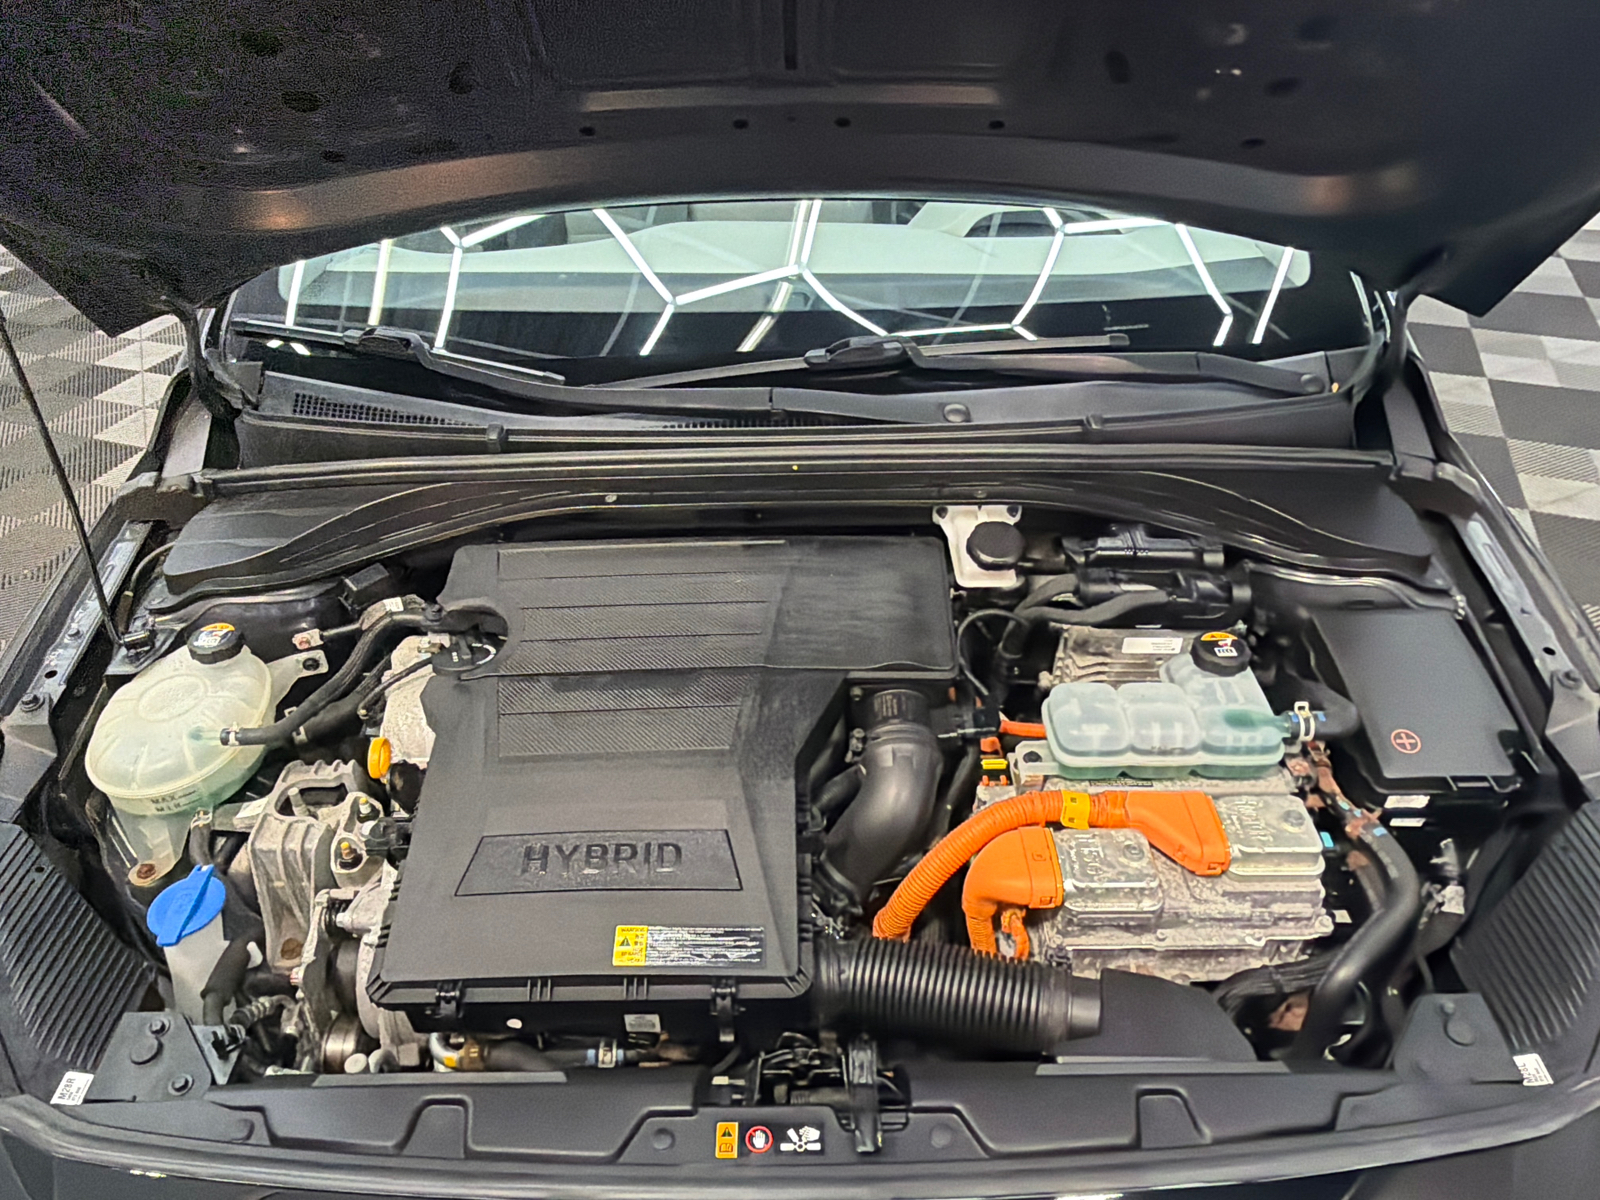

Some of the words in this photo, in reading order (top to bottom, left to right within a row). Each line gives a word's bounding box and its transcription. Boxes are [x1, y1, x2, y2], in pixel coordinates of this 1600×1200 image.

[150, 794, 177, 804] MAX
[155, 802, 181, 812] MIN
[520, 842, 683, 876] HYBRID
[57, 1078, 76, 1100] M28R
